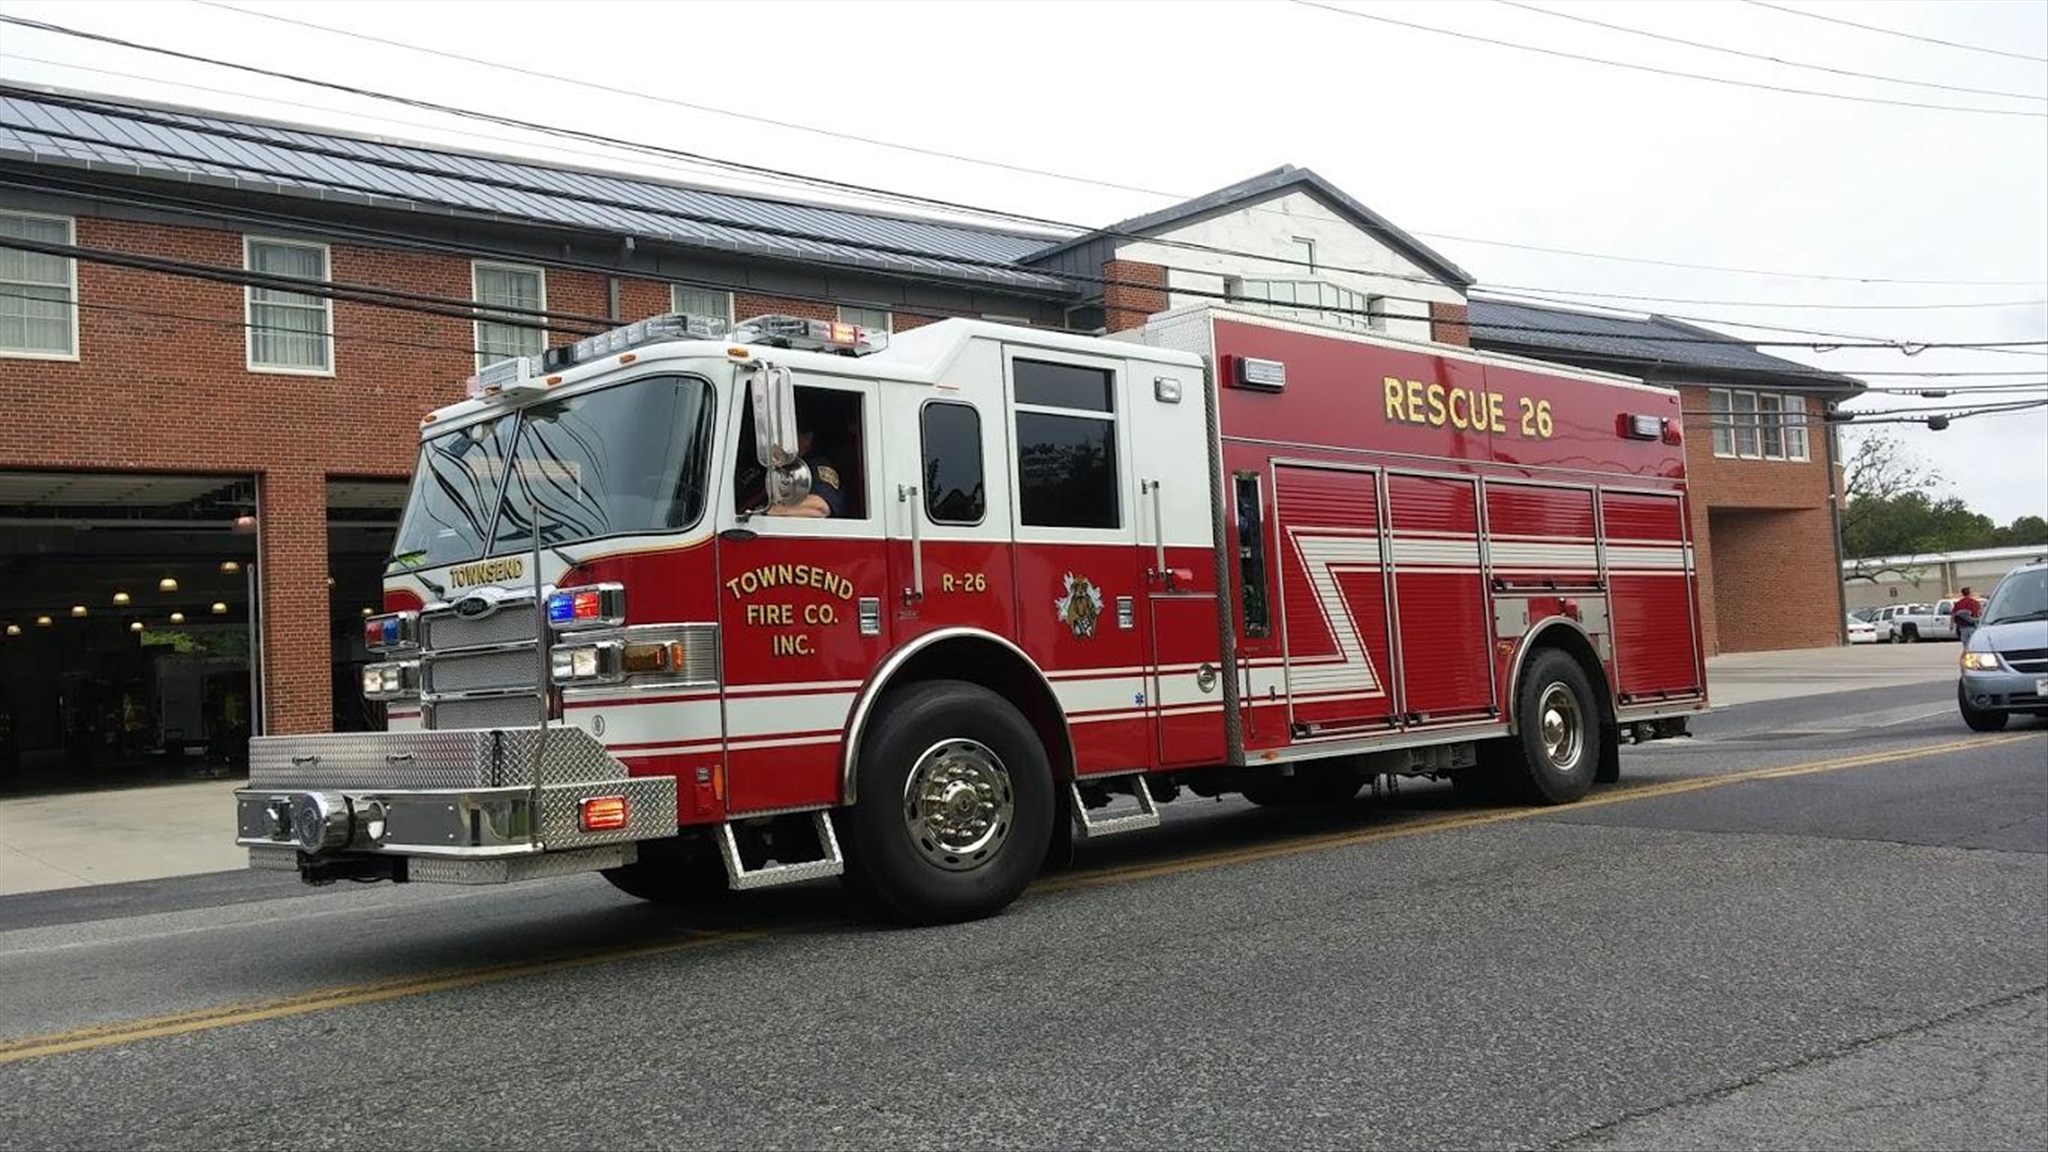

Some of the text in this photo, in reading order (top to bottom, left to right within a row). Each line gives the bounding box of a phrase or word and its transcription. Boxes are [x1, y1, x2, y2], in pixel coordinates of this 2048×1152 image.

[1384, 376, 1554, 438] RESCUE 26
[450, 558, 524, 589] TOWNSEND
[726, 564, 854, 600] TOWNSEND
[942, 573, 987, 592] R-26
[747, 603, 839, 625] FIRE CO.
[773, 634, 815, 656] INC.
